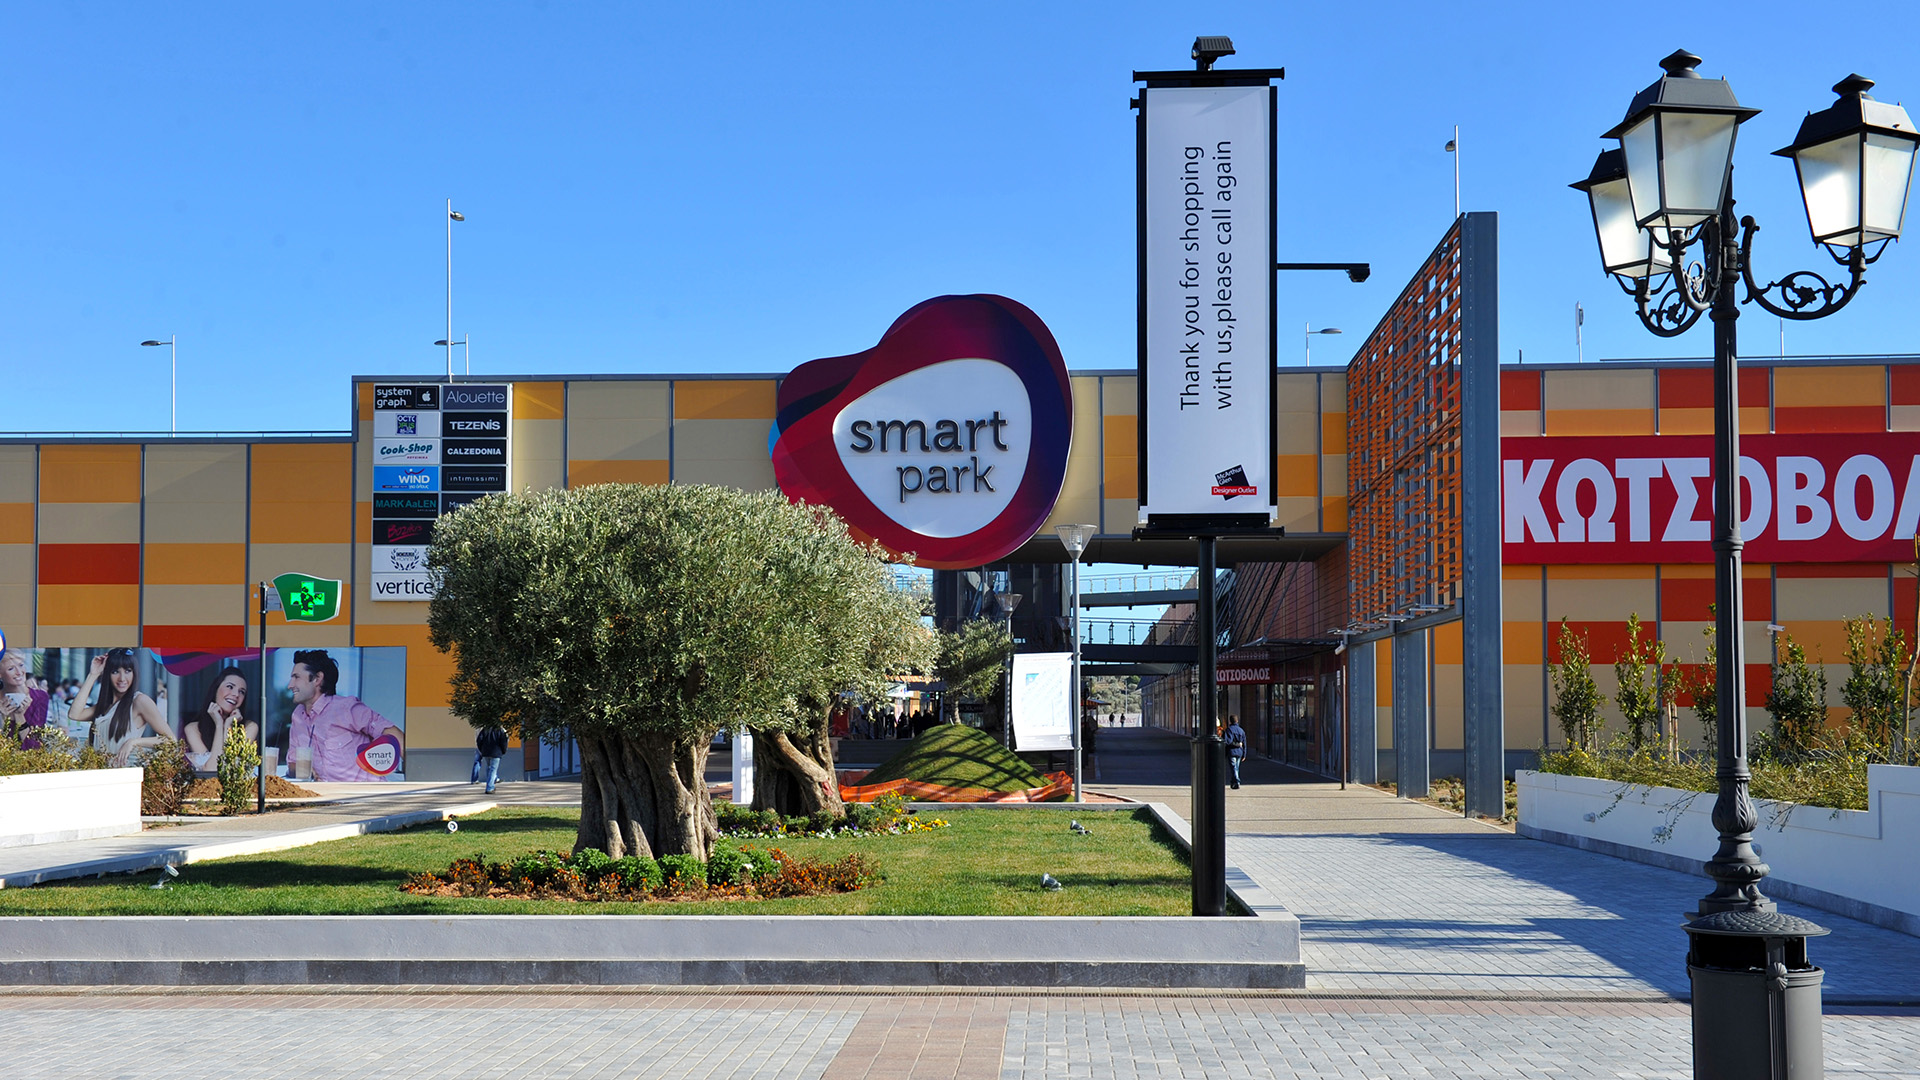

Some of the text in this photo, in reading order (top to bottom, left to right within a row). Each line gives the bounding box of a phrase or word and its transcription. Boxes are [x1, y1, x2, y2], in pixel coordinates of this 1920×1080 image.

[1212, 141, 1237, 202] again
[1211, 209, 1232, 245] call
[1179, 146, 1205, 411] Thank you for shopping
[376, 387, 412, 398] system
[1212, 361, 1232, 410] with
[376, 397, 407, 409] graph
[445, 390, 505, 404] Alouette
[850, 410, 1009, 453] smart
[380, 443, 433, 455] Cook-Shop
[447, 448, 502, 456] CALZEDONIA
[398, 475, 430, 484] WIND
[896, 456, 997, 503] park
[1213, 487, 1237, 495] Designer
[375, 579, 434, 595] vertice
